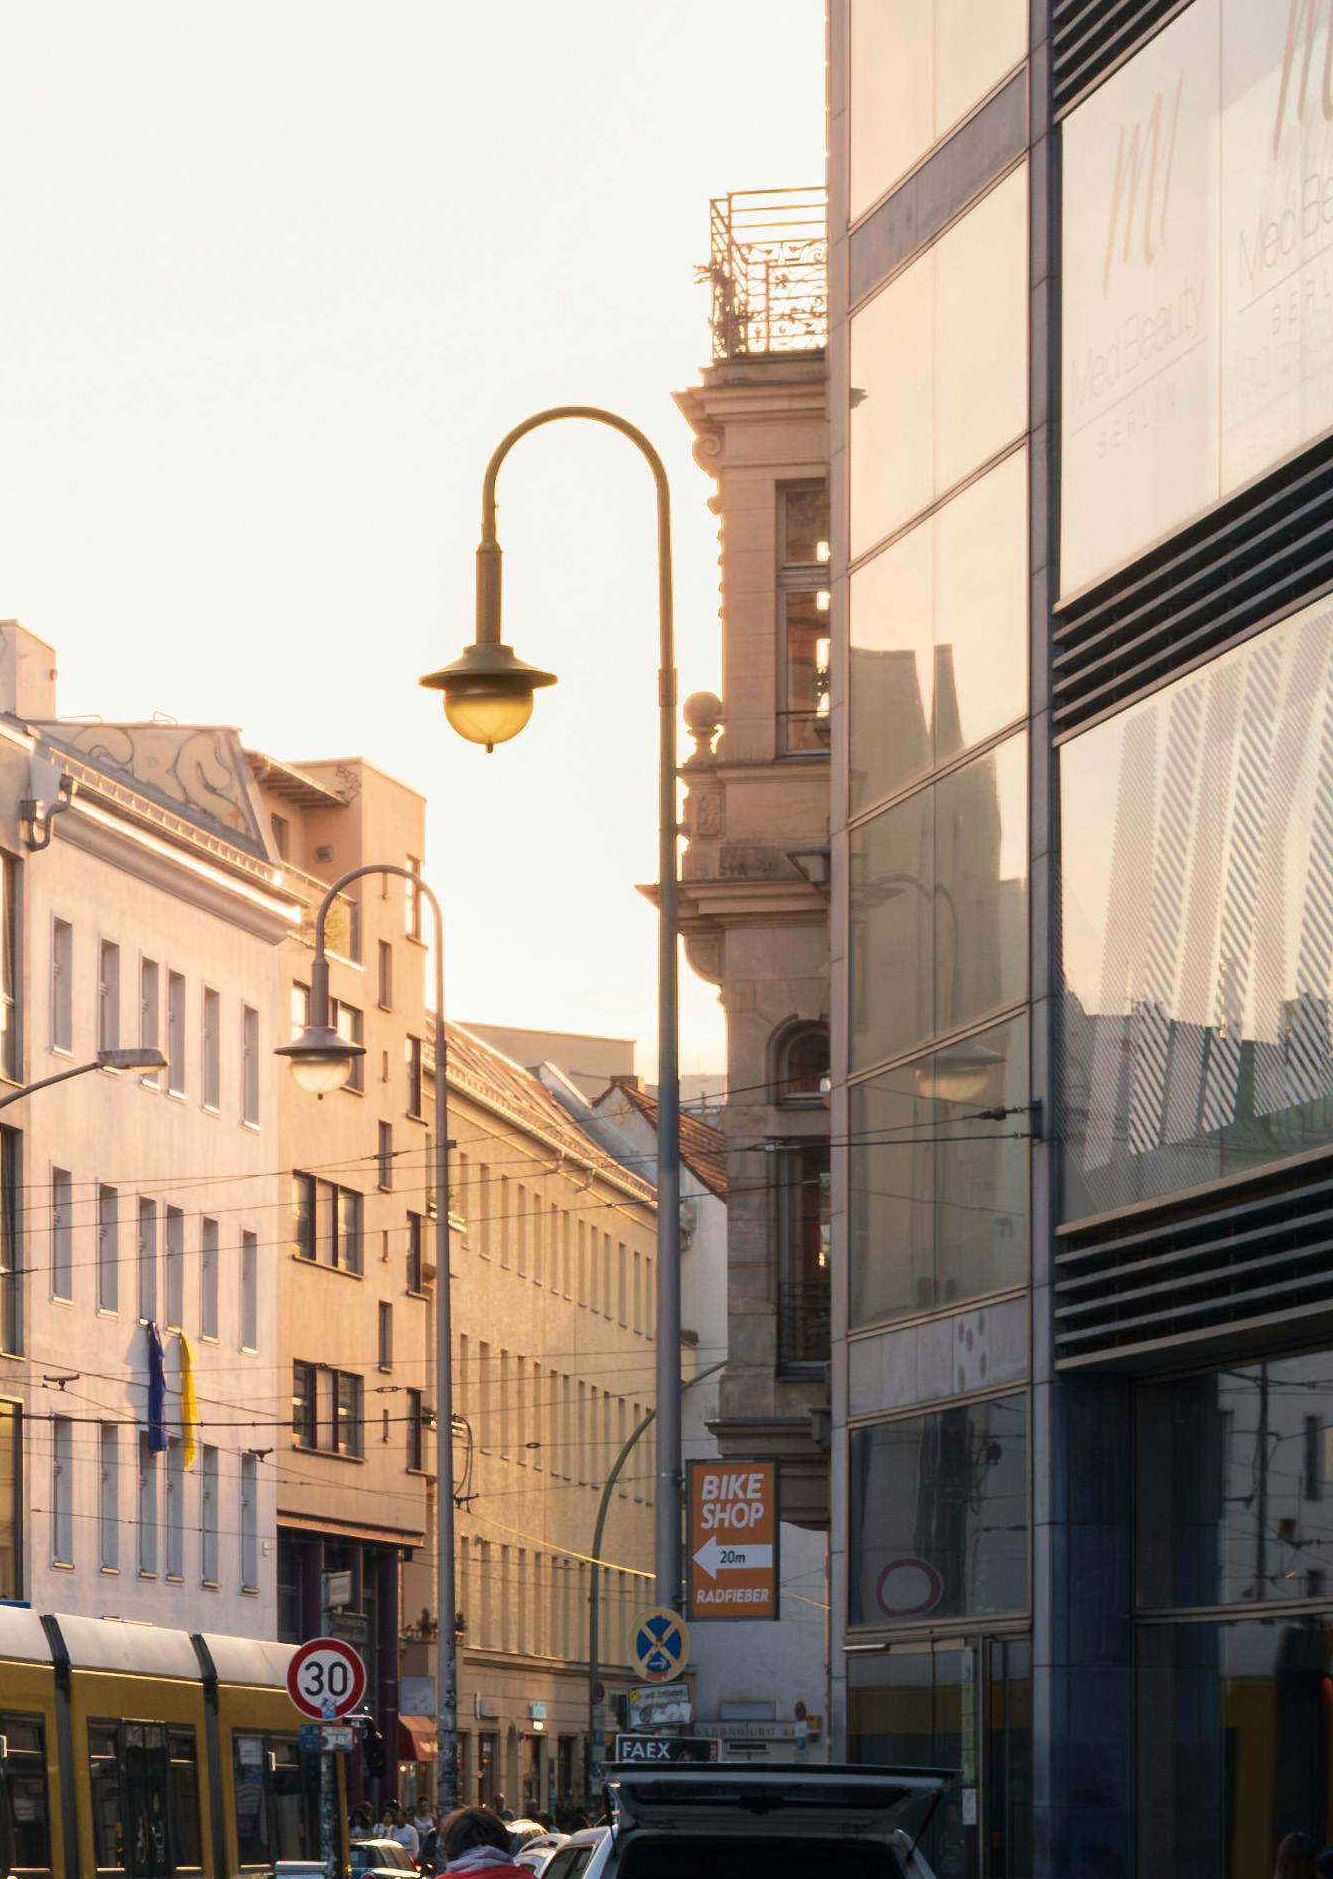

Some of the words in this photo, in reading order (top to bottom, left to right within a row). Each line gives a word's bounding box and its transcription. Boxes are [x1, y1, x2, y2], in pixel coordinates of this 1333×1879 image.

[701, 1473, 765, 1500] BIKE
[701, 1502, 765, 1530] SHOP
[720, 1550, 746, 1564] 20m
[696, 1588, 770, 1603] RADFIEBER
[304, 1661, 348, 1697] 30
[622, 1741, 671, 1759] FAEX
